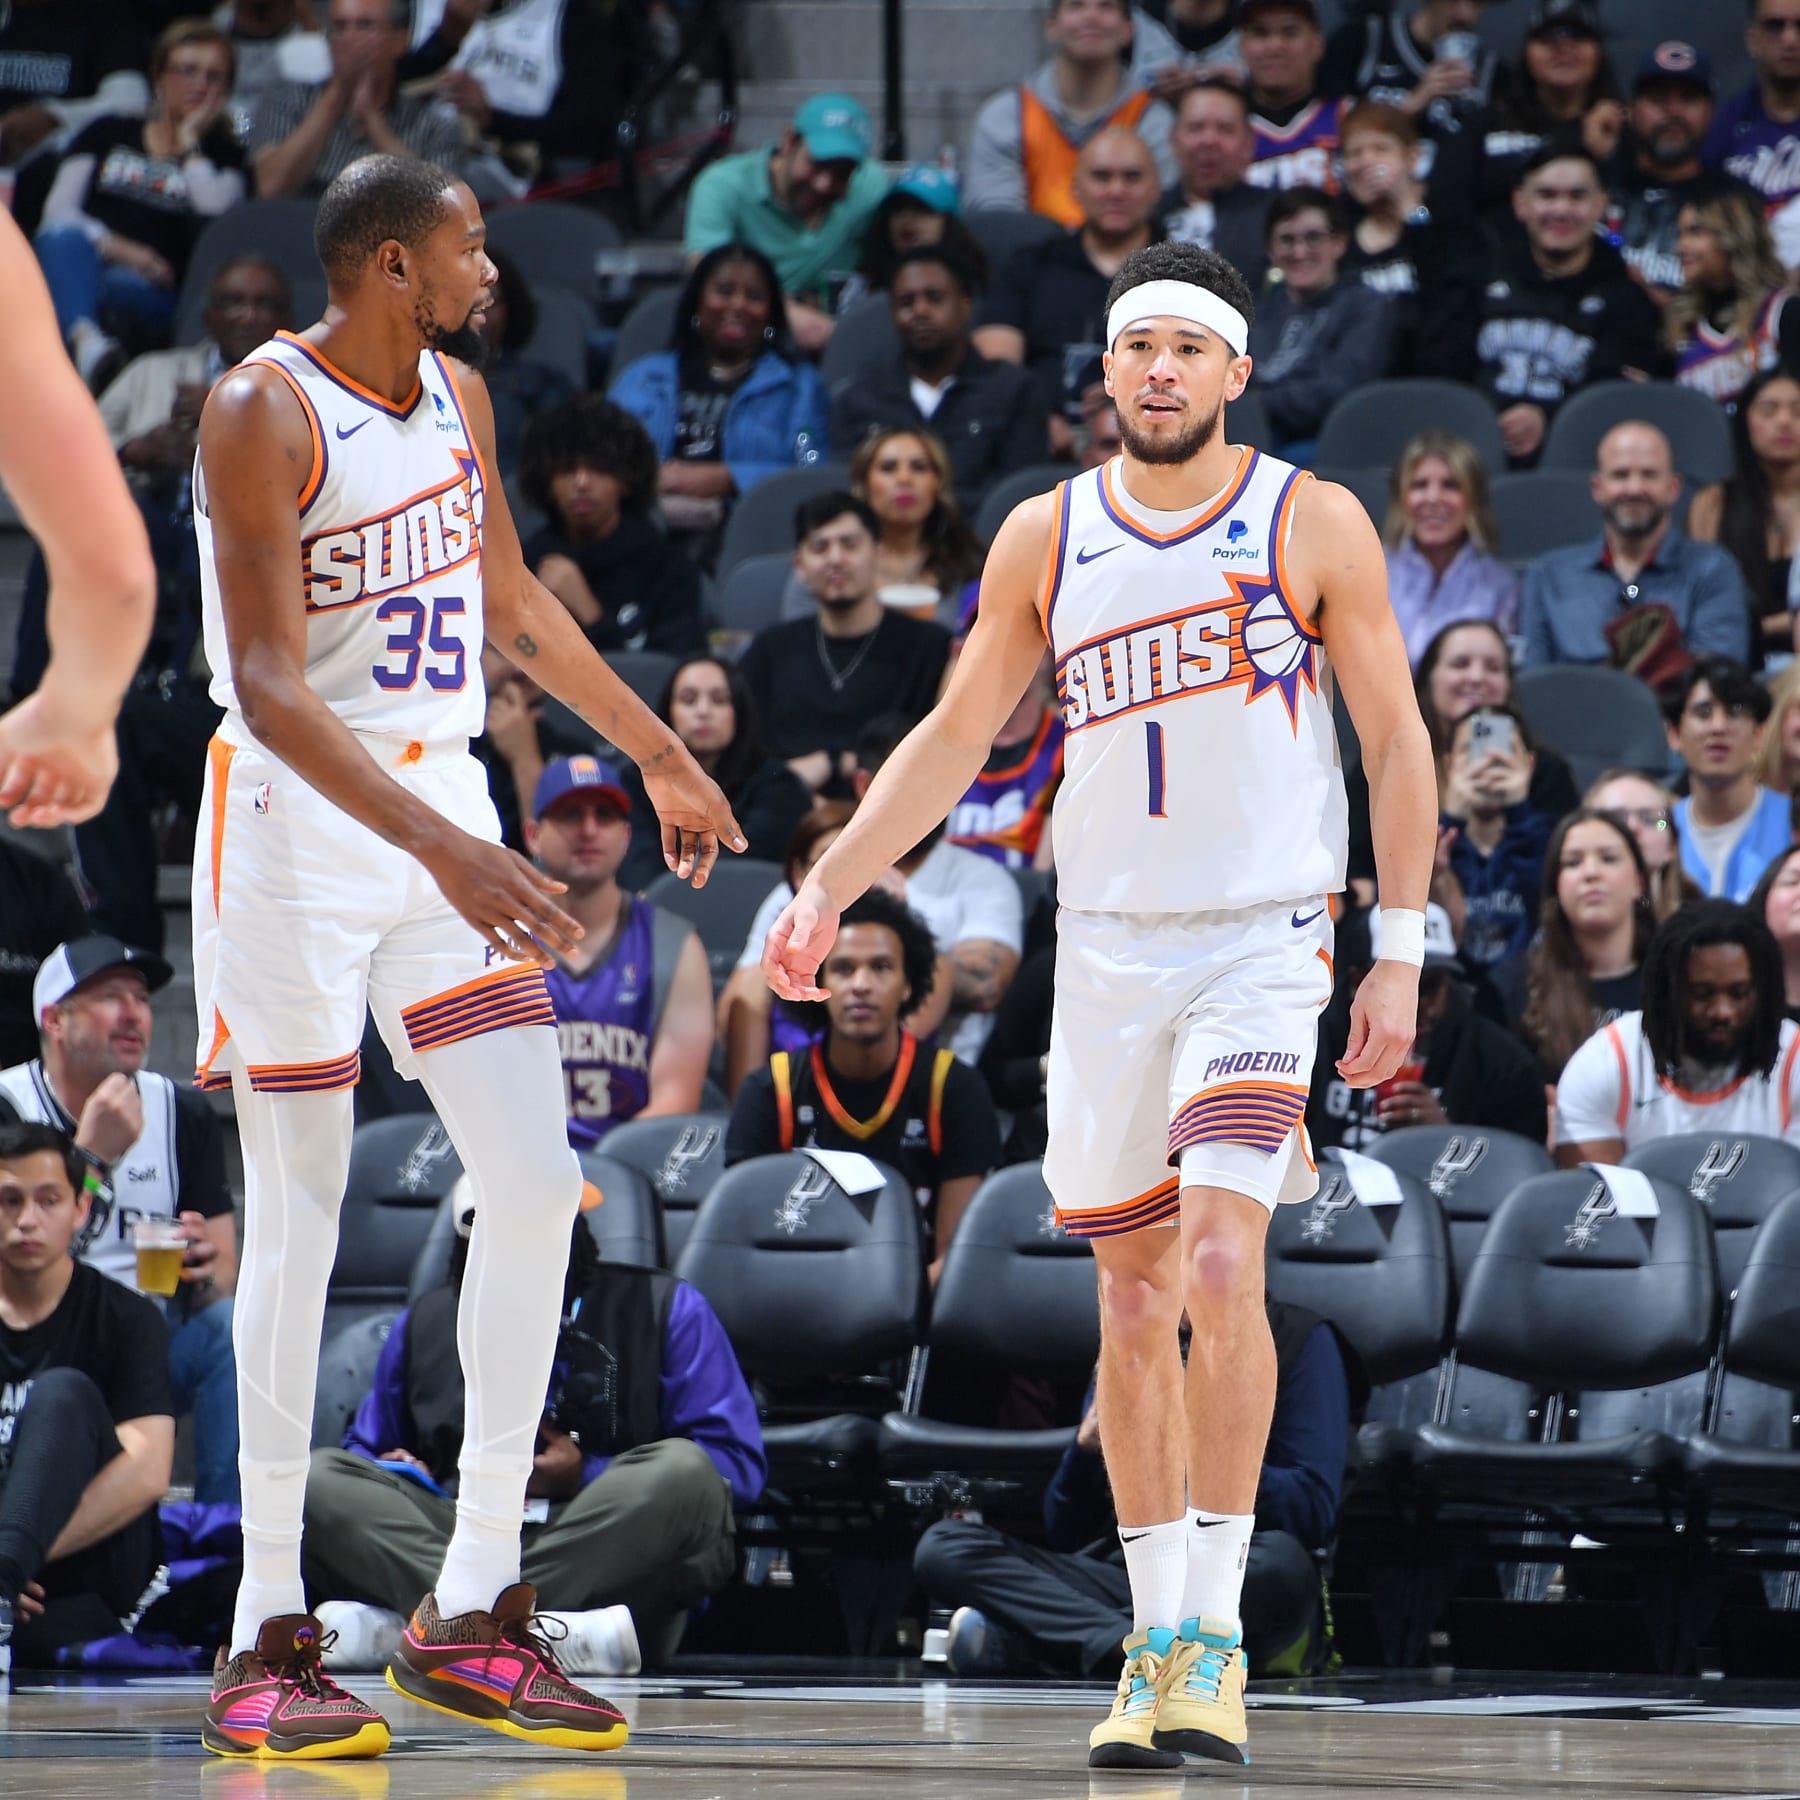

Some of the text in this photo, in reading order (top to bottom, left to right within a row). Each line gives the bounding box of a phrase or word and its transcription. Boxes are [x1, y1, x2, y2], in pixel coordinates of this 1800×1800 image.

[435, 420, 459, 432] PayPal
[310, 486, 471, 607] SUNS
[1211, 547, 1260, 560] PayPal
[372, 596, 467, 692] 35
[1066, 609, 1232, 729] SUNS
[1144, 721, 1168, 818] 1
[1202, 1051, 1301, 1082] PHOENIX
